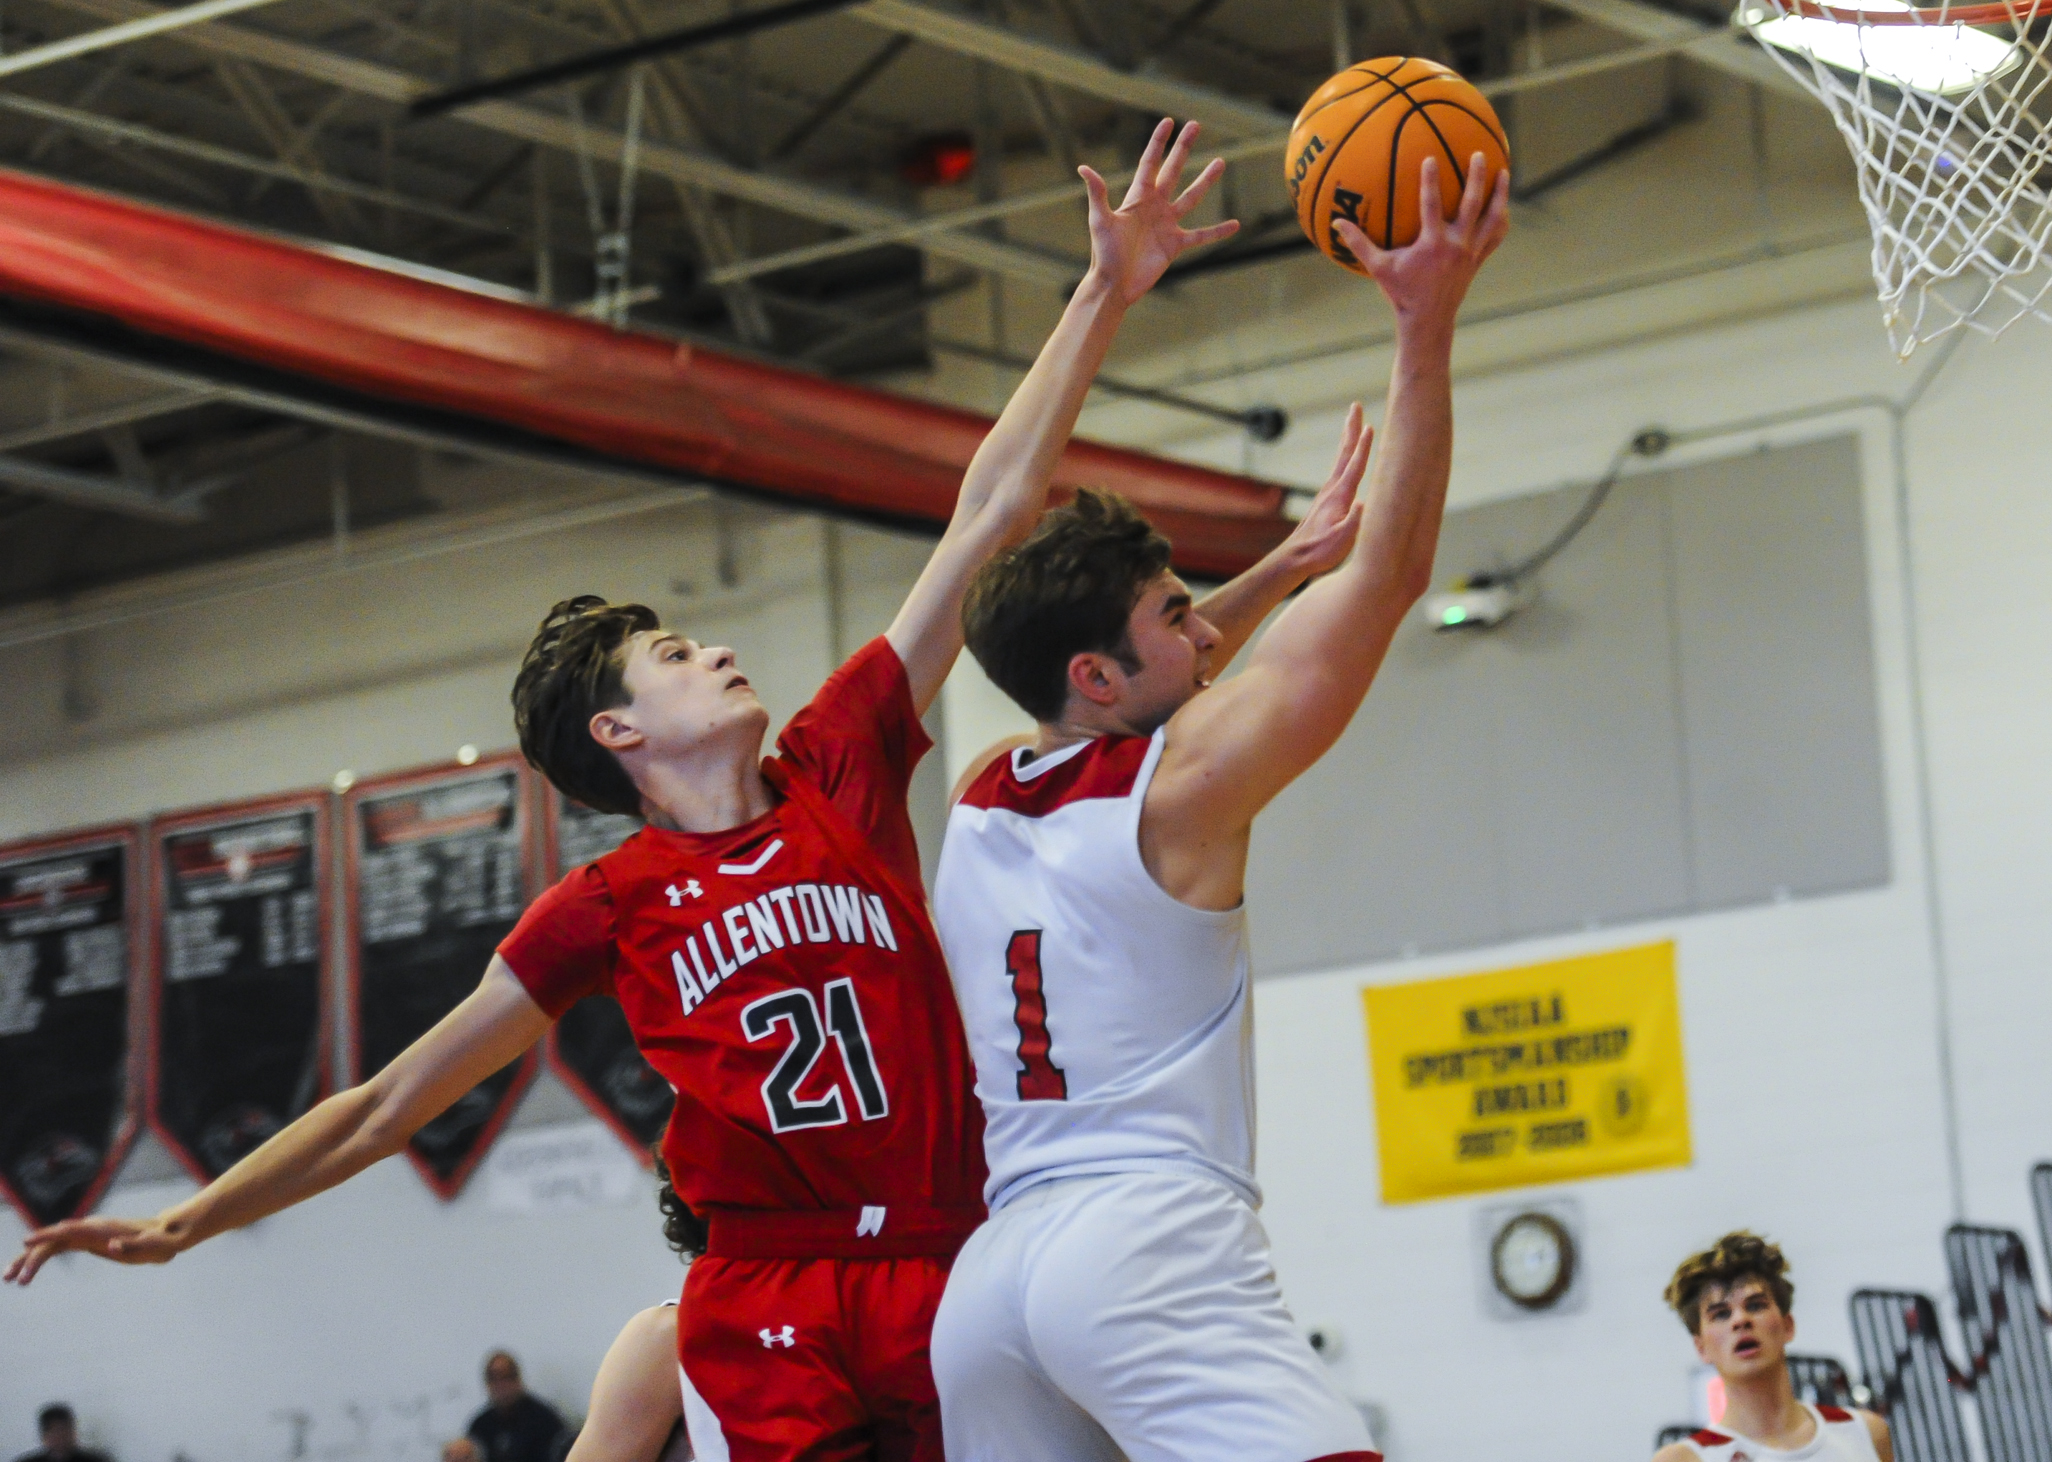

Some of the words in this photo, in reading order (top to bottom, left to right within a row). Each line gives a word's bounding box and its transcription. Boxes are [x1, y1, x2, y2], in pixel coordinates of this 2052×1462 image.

[670, 883, 898, 1017] ALLENTOWN
[1006, 929, 1067, 1102] 1
[740, 977, 889, 1135] 21
